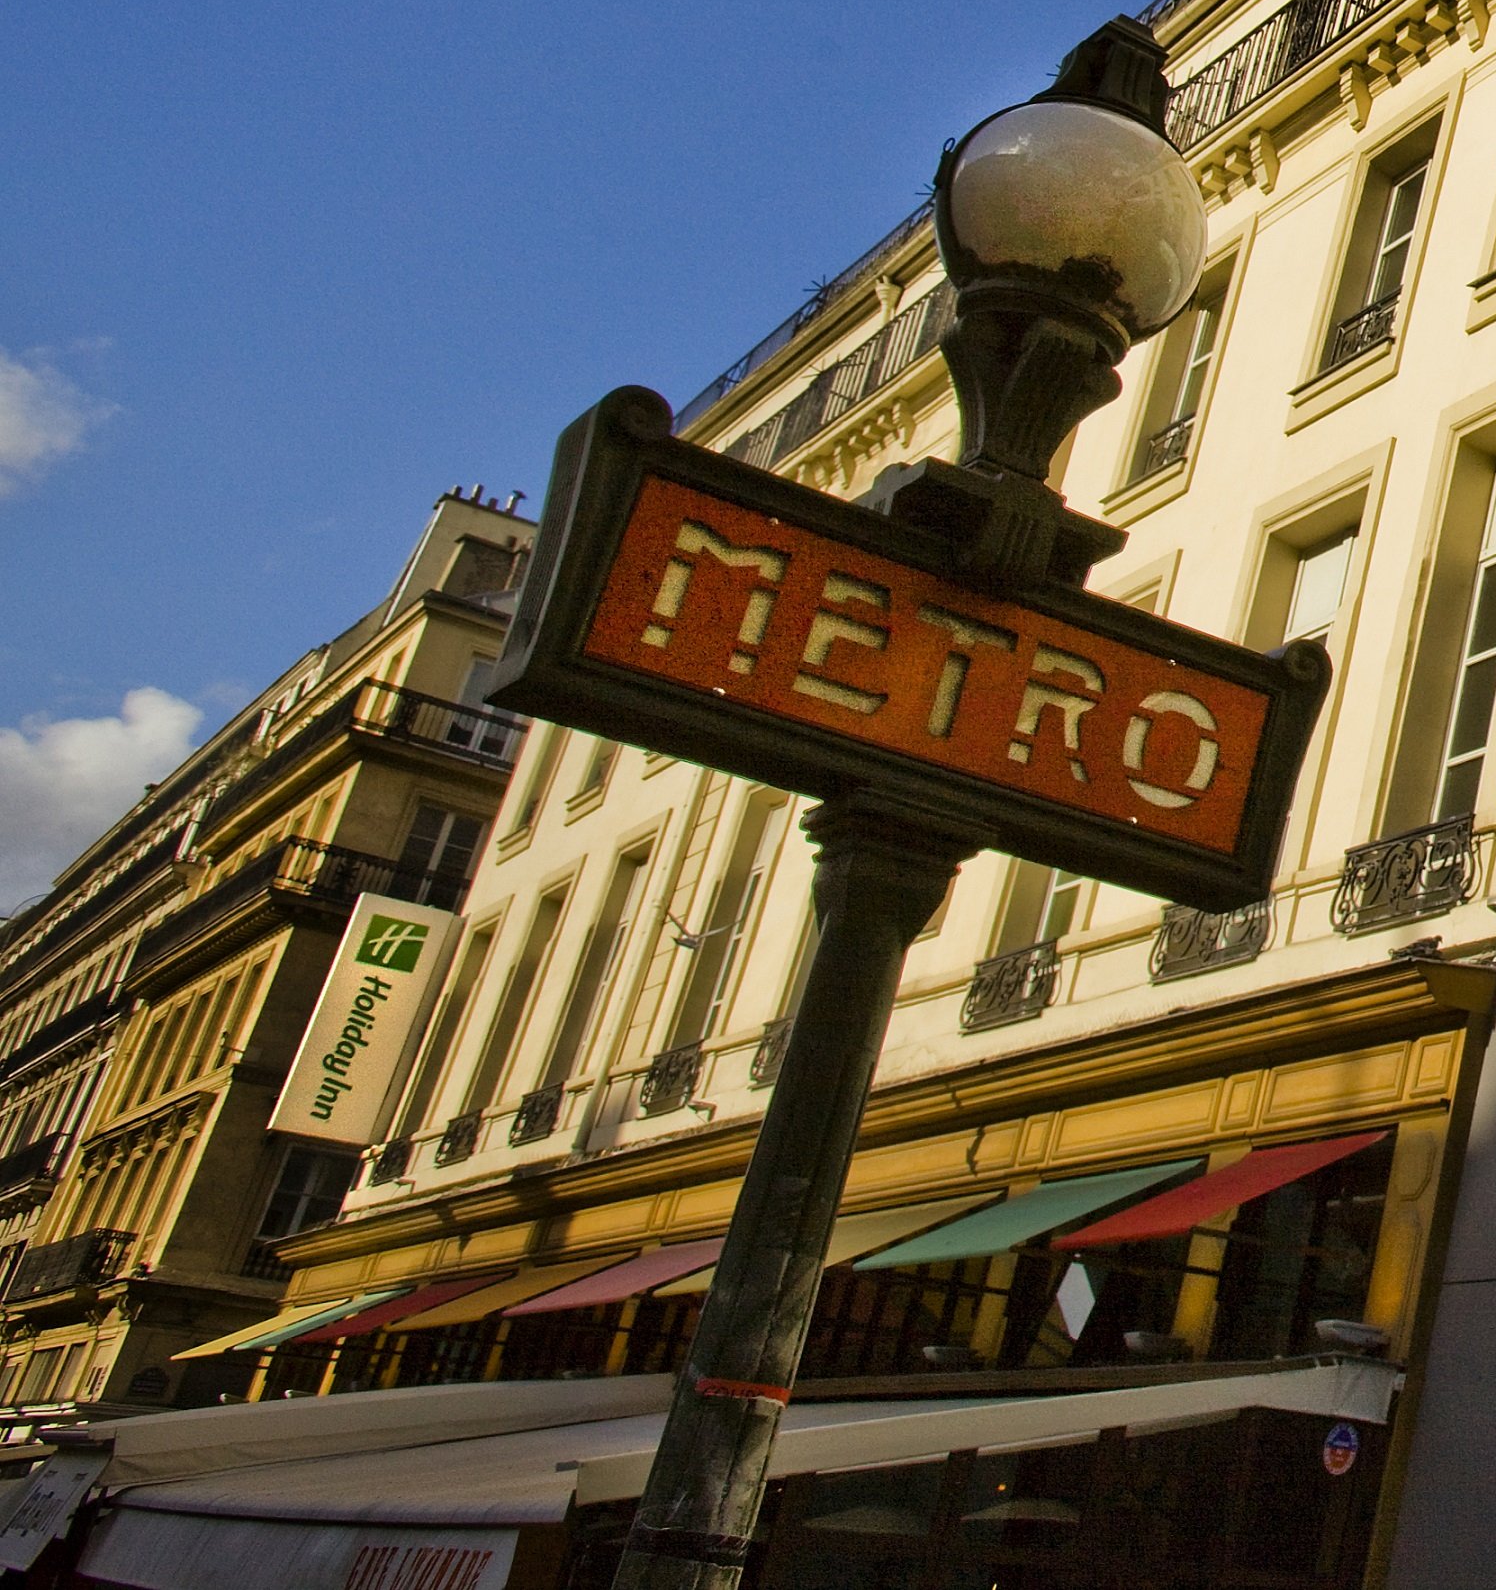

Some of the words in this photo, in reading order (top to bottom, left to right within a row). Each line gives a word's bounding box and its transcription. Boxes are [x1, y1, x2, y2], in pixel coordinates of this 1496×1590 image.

[641, 517, 1220, 809] METRO
[322, 975, 392, 1077] Holiday
[310, 1077, 353, 1121] Inn
